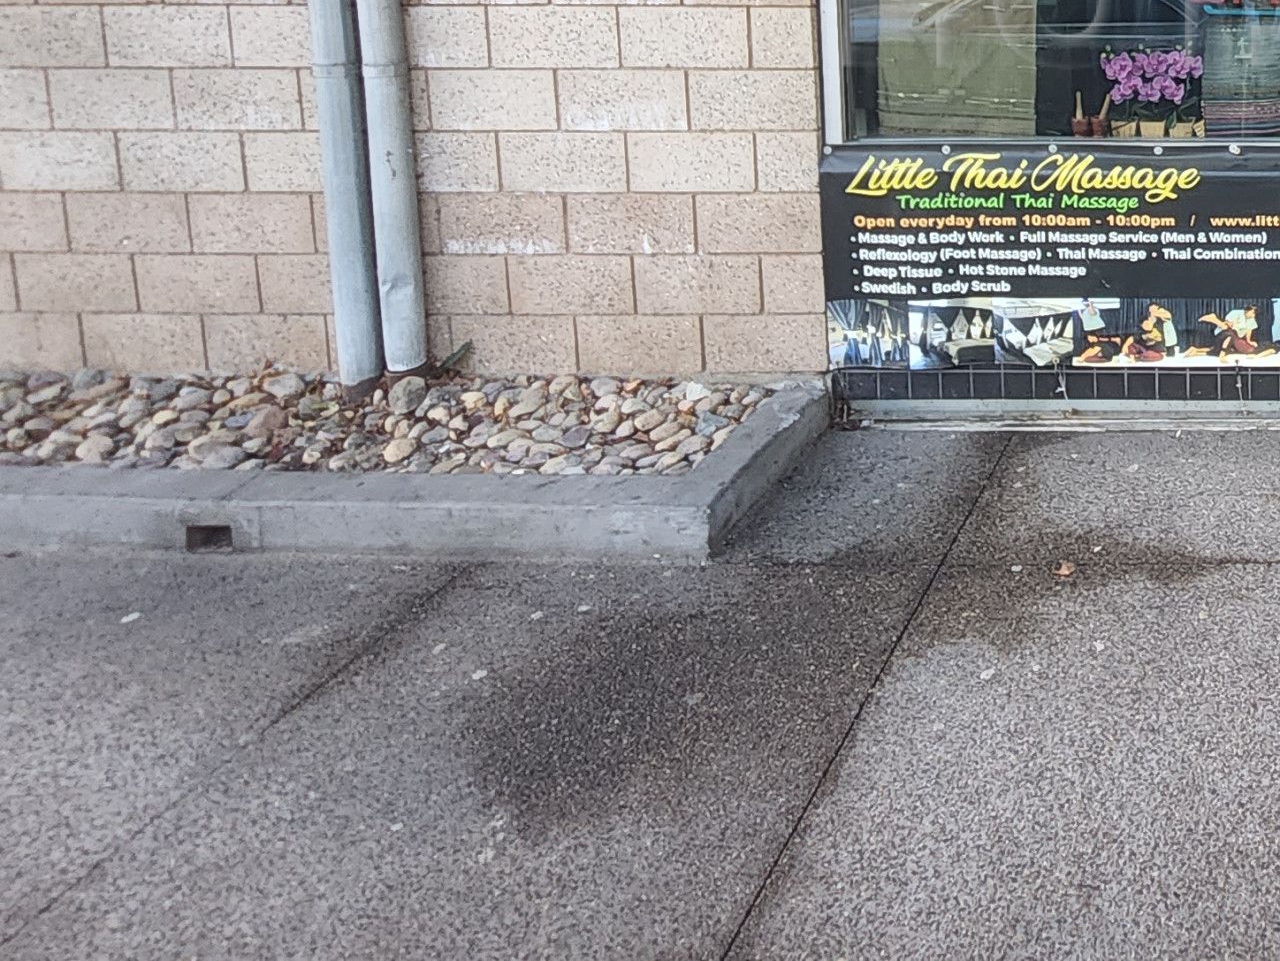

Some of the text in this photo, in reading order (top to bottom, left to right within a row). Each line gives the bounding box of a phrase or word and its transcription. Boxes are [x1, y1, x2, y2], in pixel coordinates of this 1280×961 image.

[845, 153, 1200, 203] Little Thai Massage
[896, 194, 1139, 213] Traditional Thai Massage
[854, 216, 895, 229] Open
[900, 216, 975, 229] everyday
[978, 216, 1017, 226] from
[1022, 215, 1091, 227] 10:00am
[1106, 215, 1175, 228] 10:00pm
[858, 232, 1267, 246] Massage & Body Work Full Massage Service (Men & Women)
[859, 249, 937, 263] Reflexology
[940, 248, 976, 261] (Foot
[978, 248, 1041, 261] Massage)
[1057, 248, 1086, 260] Thai
[1088, 249, 1146, 261] Massage
[1162, 248, 1191, 260] Thai
[863, 264, 1086, 279] Deep Tissue Hot Stone Massage
[861, 281, 1011, 295] Swedish Body Scrub
